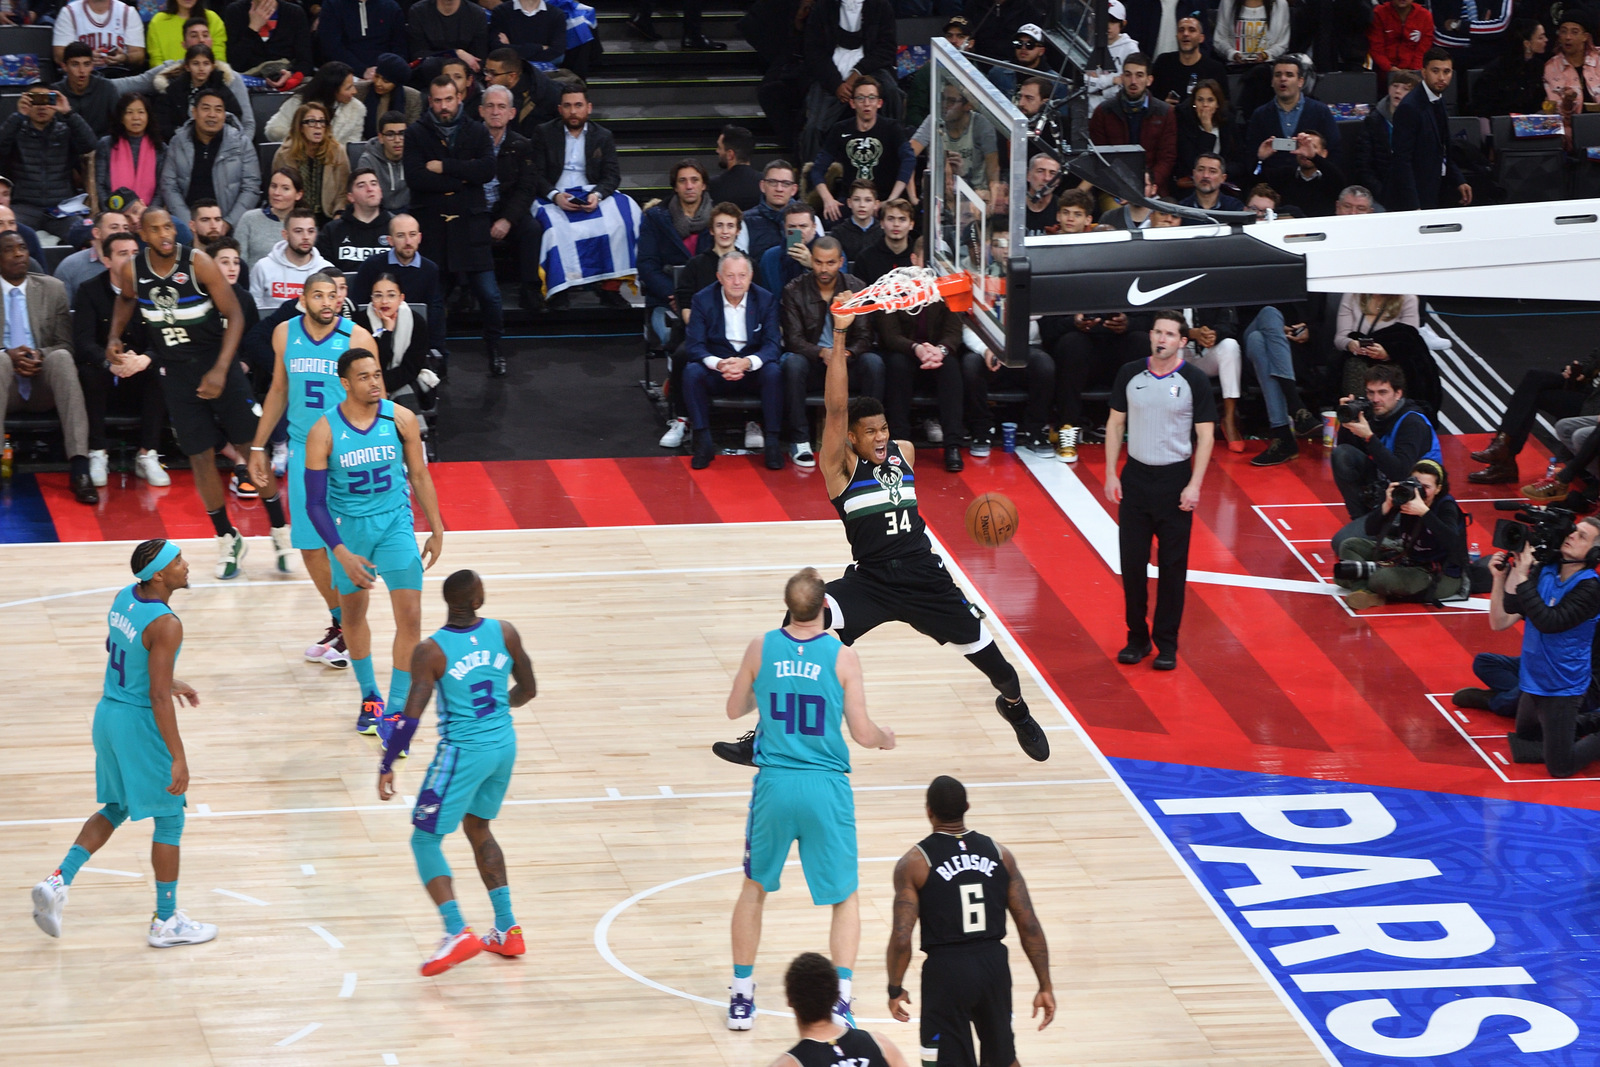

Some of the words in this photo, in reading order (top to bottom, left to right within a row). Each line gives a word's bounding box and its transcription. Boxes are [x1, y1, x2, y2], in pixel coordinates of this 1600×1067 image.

[274, 283, 304, 298] Supre
[161, 327, 191, 347] 22
[305, 380, 325, 409] 5
[339, 445, 396, 468] HORNETS
[347, 464, 392, 495] 25
[884, 509, 912, 535] 34
[110, 641, 126, 688] 4
[447, 649, 491, 681] ROZIER
[773, 660, 822, 681] ZELLER
[469, 679, 497, 719] 3
[769, 692, 827, 736] 40
[935, 853, 999, 882] BLEDSOE
[959, 882, 987, 933] 6
[1153, 791, 1580, 1058] PARIS
